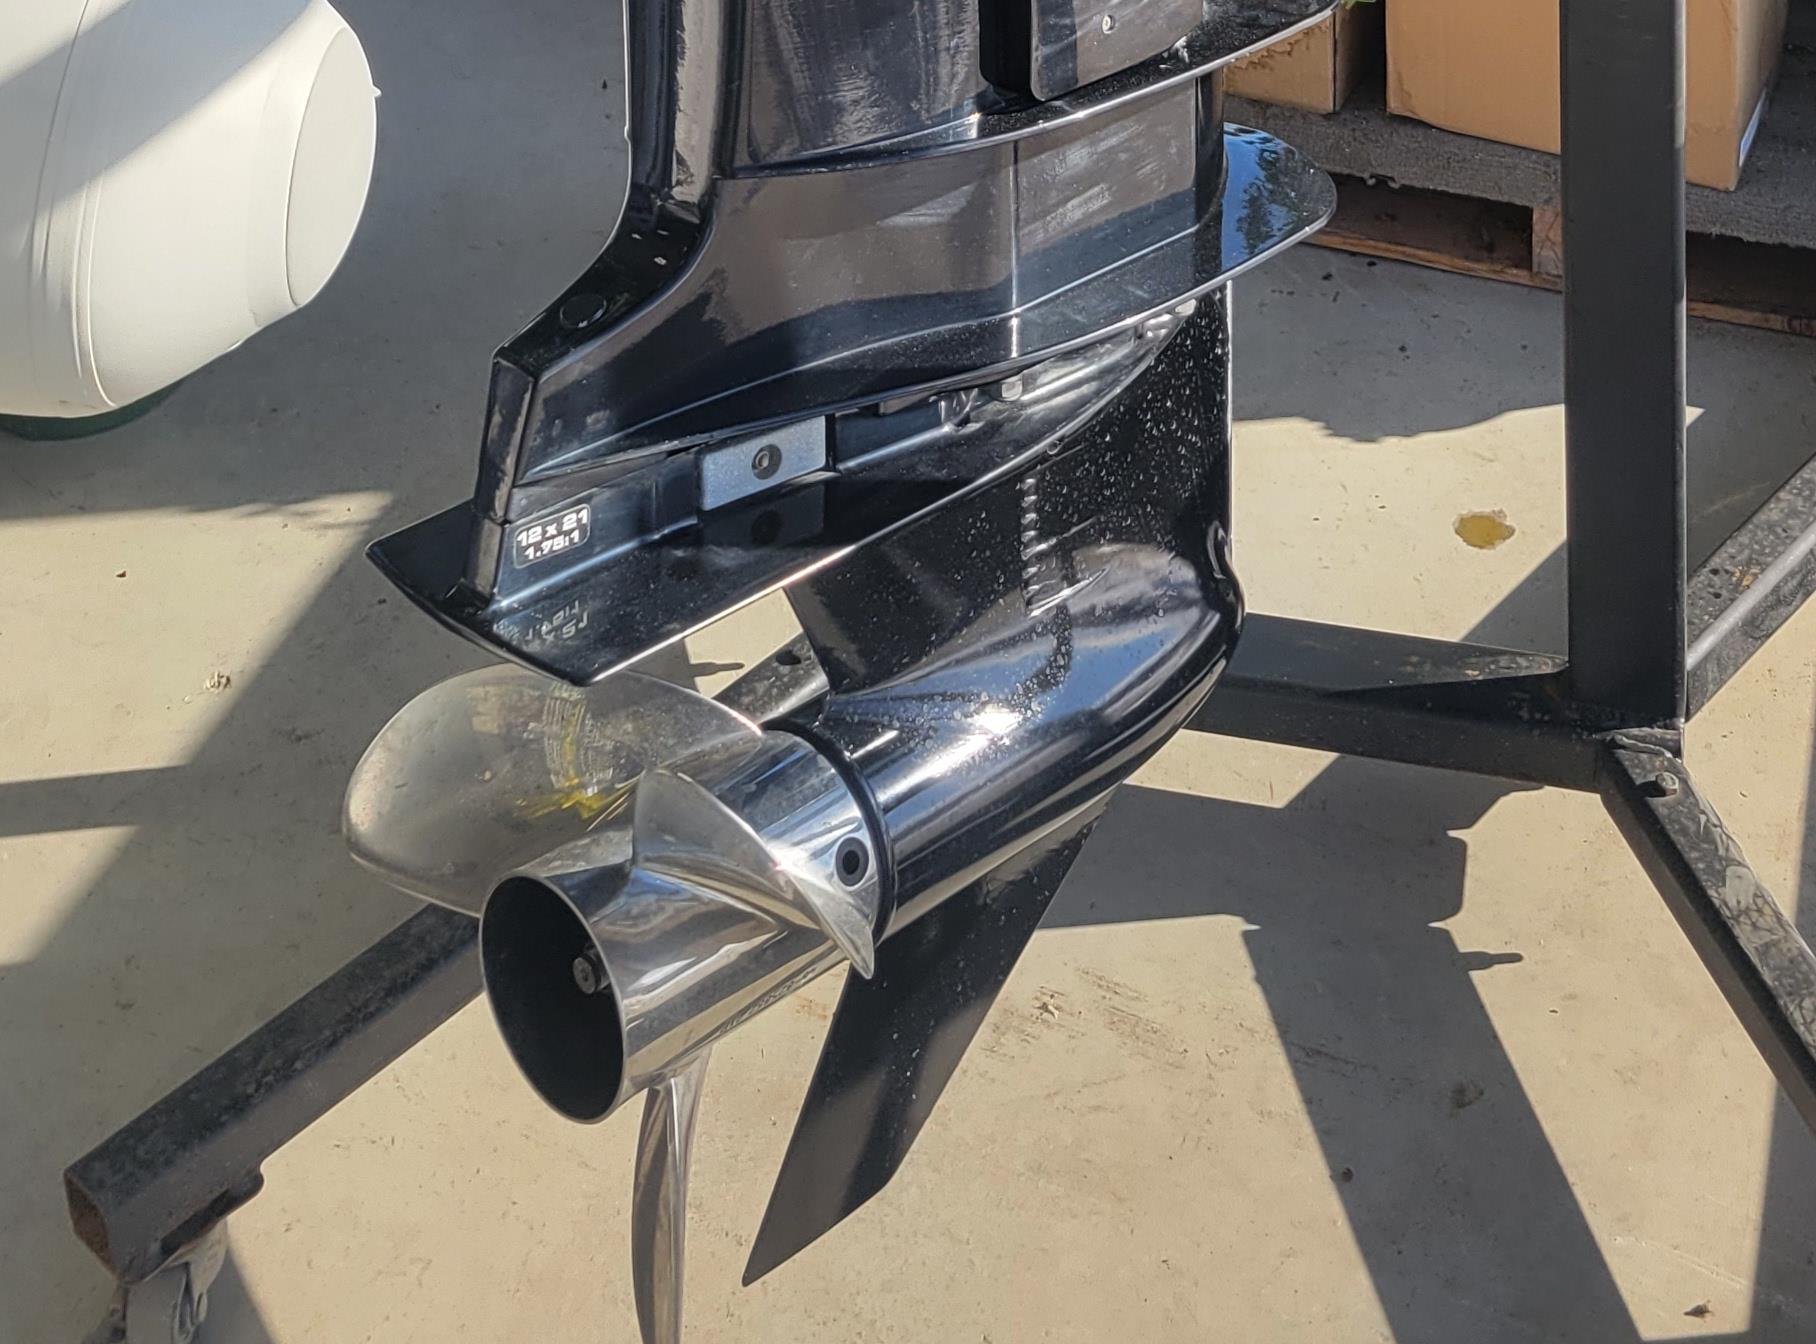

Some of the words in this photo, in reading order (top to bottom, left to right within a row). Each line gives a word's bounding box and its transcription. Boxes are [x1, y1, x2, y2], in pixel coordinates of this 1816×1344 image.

[516, 524, 543, 547] 12
[562, 508, 588, 531] 21
[523, 529, 580, 560] 1.75:1
